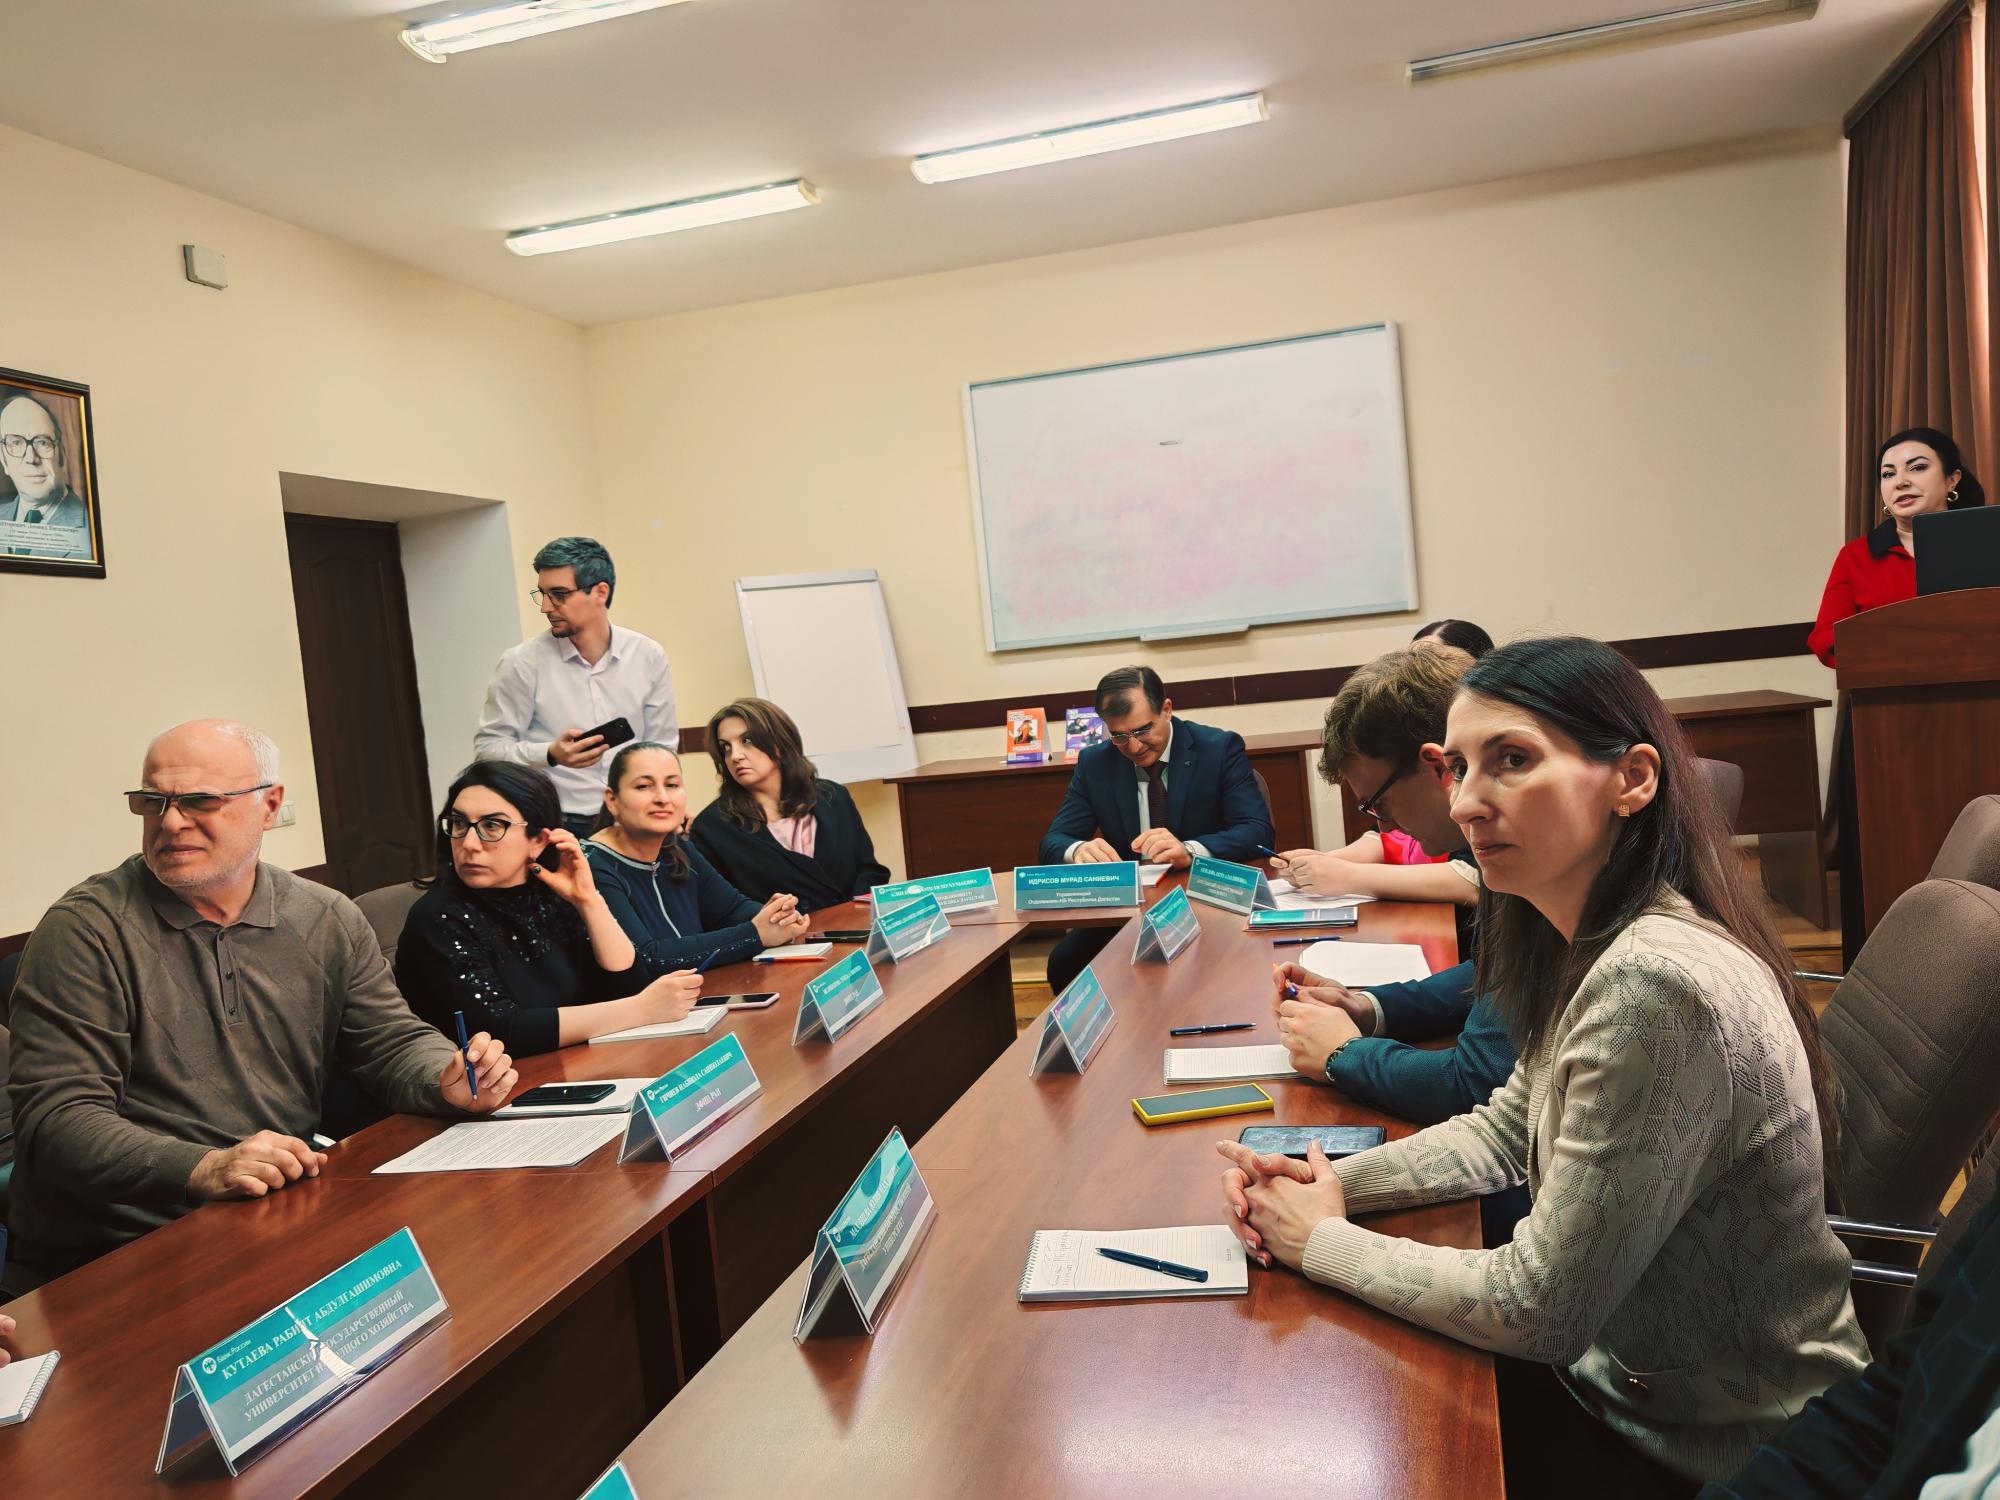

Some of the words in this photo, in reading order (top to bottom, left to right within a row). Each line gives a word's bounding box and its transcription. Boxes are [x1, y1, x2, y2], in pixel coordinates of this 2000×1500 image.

[1060, 876, 1083, 884] МУРАД
[222, 1342, 273, 1380] КУТАЕВА
[272, 1315, 312, 1348] РАБИТ
[314, 1259, 402, 1322] АБДУЛГАШИМОВНА
[244, 1368, 314, 1421] УНИВЕРСИТЕТ
[368, 1301, 414, 1336] ХОЗЯЙСТВА
[322, 1290, 404, 1351] ОСУДАРСТВЕННЫЙ
